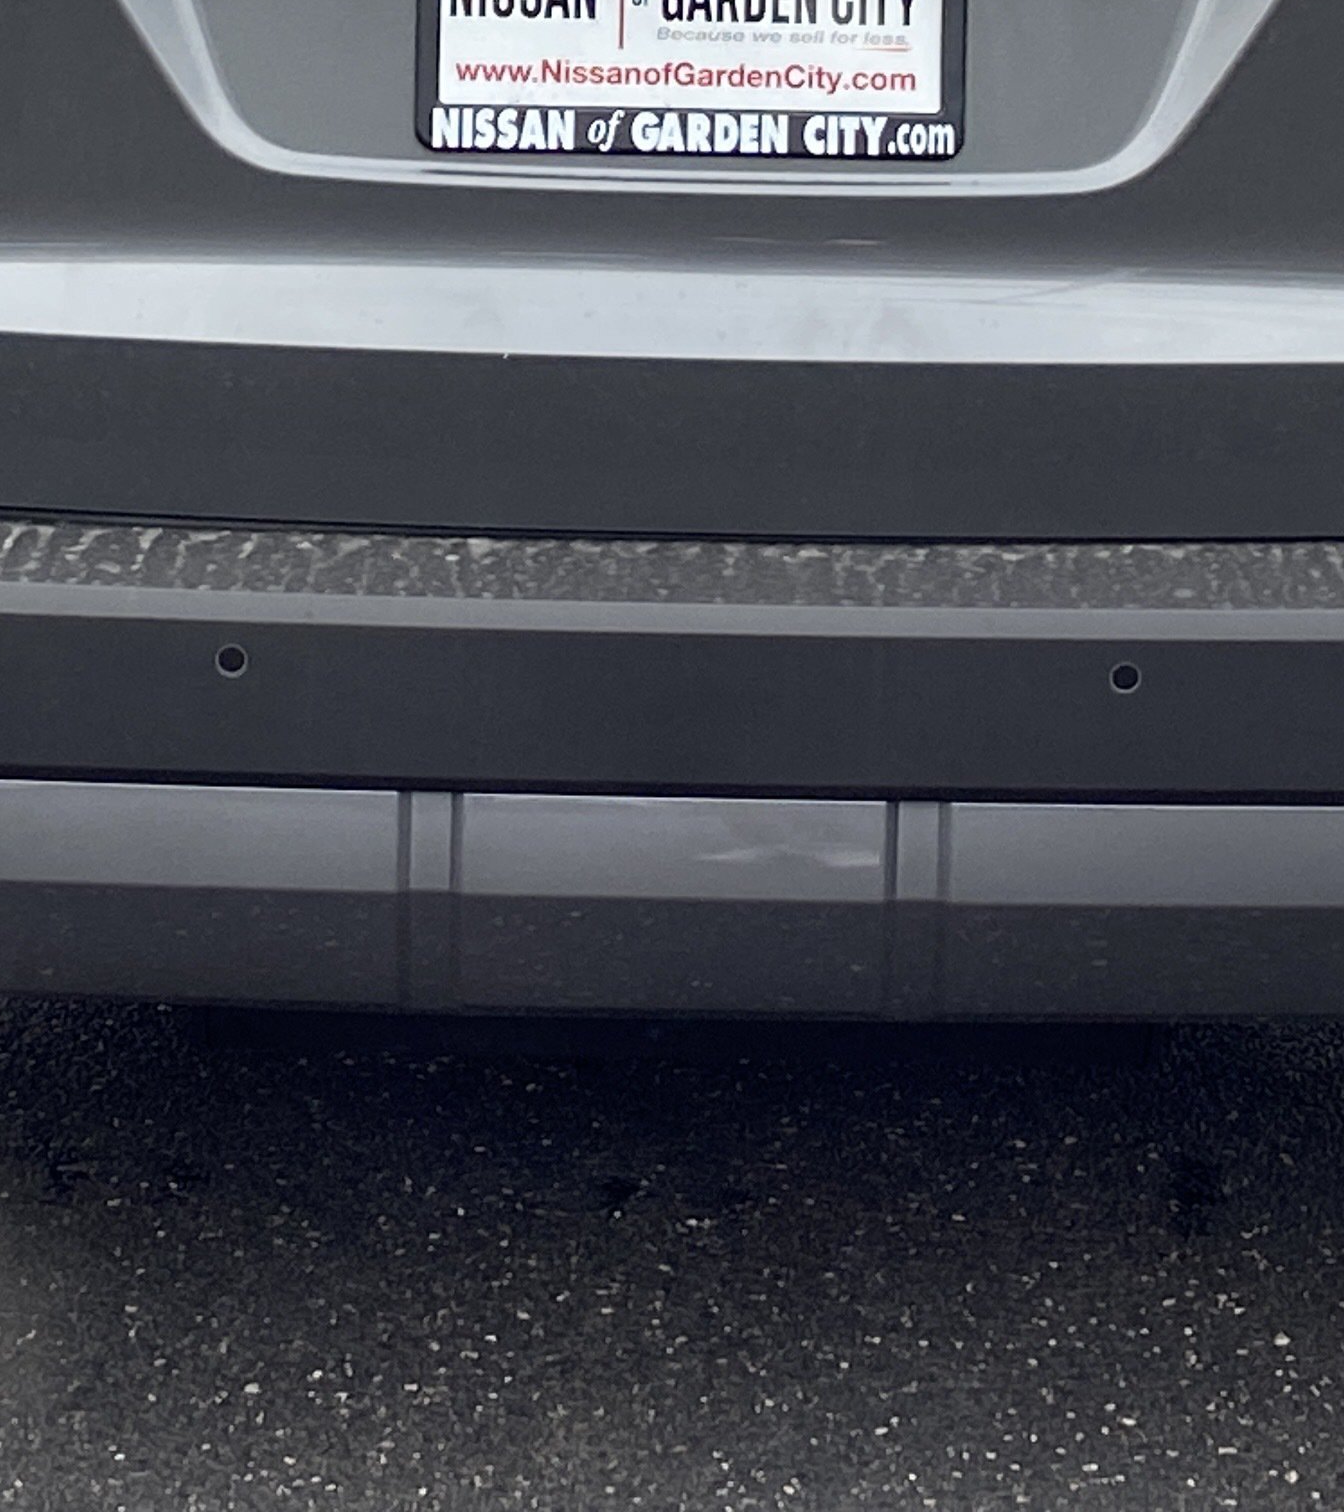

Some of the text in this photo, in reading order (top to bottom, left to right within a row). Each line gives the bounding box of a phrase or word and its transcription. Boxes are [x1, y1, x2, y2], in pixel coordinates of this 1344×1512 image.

[657, 26, 745, 43] Because
[830, 30, 858, 45] for
[455, 59, 917, 94] www.NissanofGardenCity.com
[432, 107, 955, 156] NISSAN of GARDEN CITY.com
